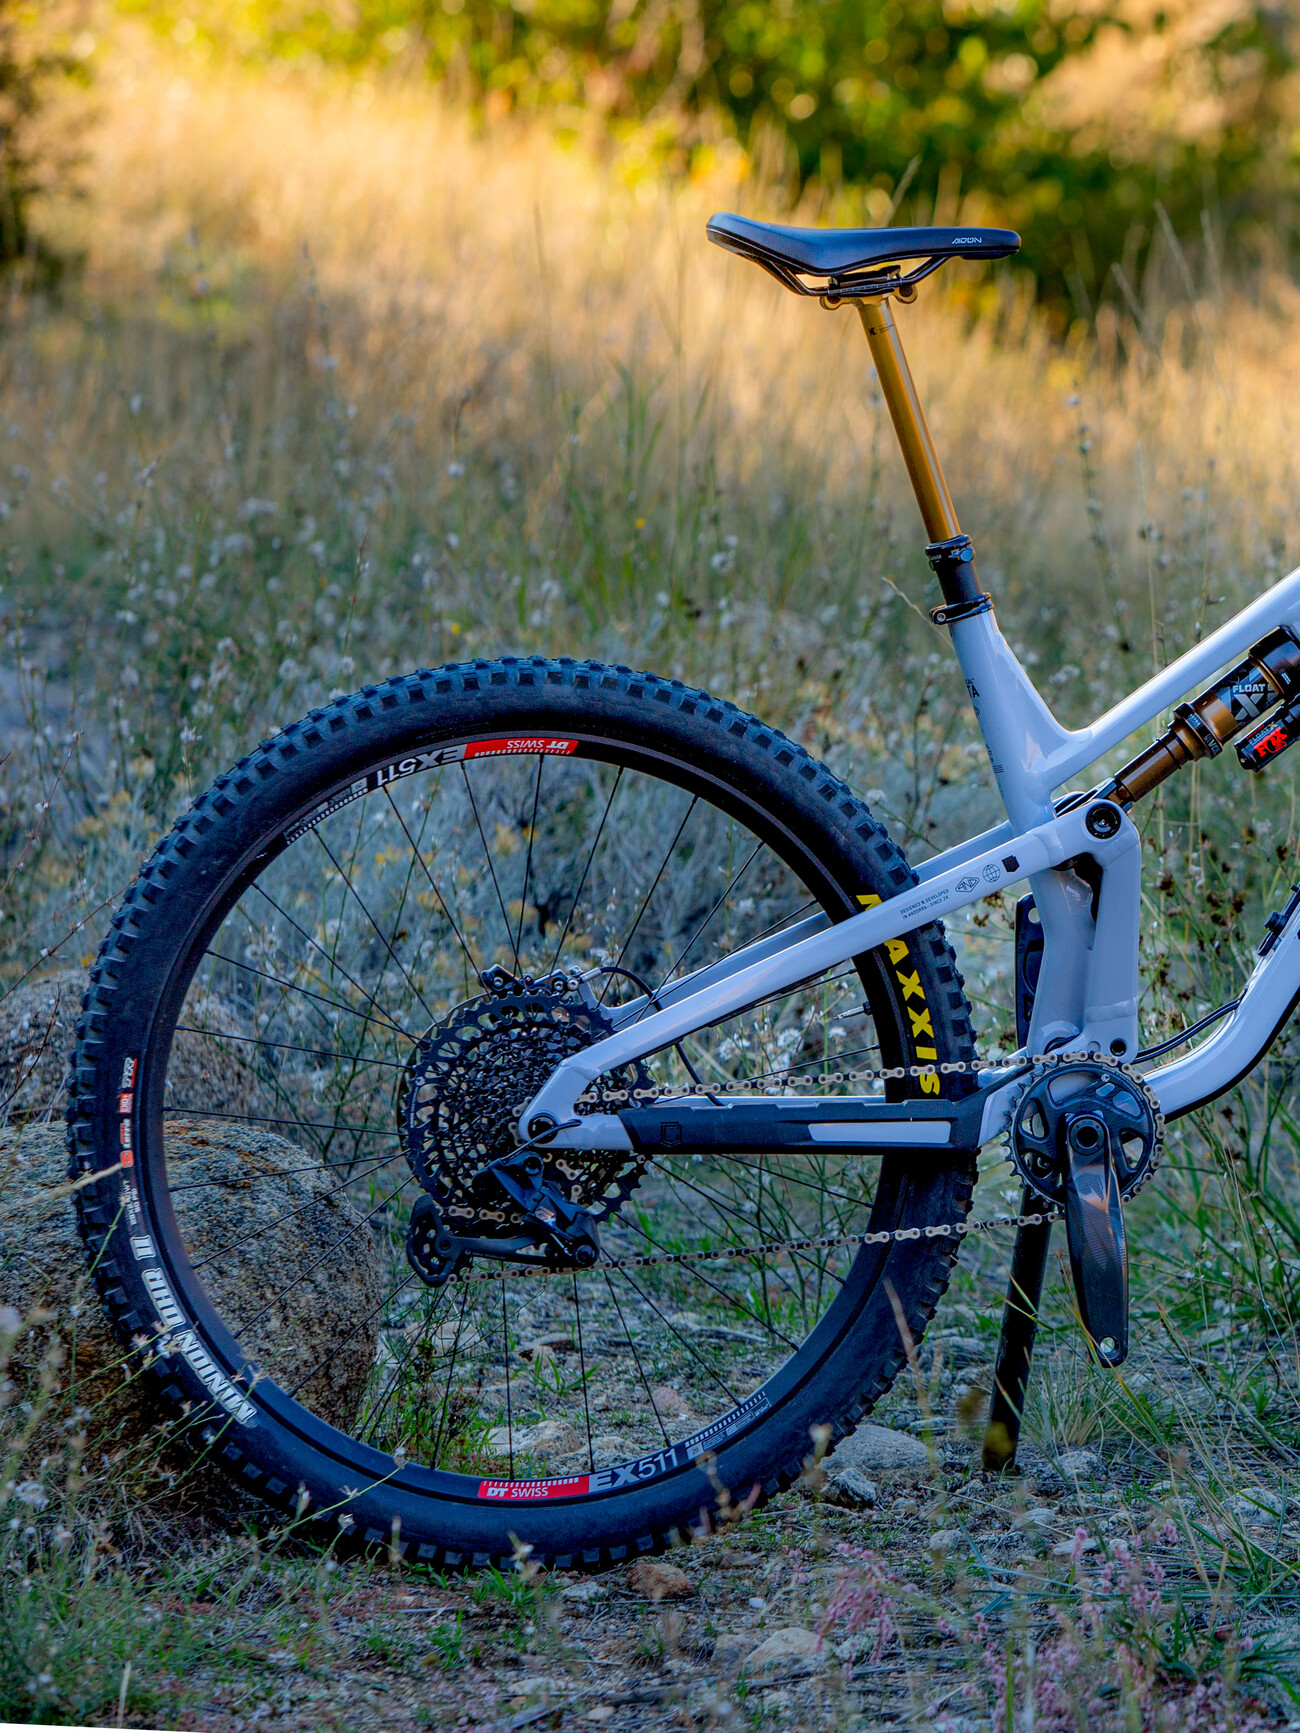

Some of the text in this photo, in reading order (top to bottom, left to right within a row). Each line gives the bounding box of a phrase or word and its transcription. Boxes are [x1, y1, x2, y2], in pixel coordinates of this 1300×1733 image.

[1232, 684, 1266, 693] FLOAT
[506, 740, 570, 750] DT SWISS
[1253, 726, 1288, 757] FOX
[376, 744, 466, 787] EX511
[130, 1235, 259, 1426] MINION DHR II
[589, 1448, 679, 1492] EX511
[486, 1484, 548, 1497] DT SWISS
